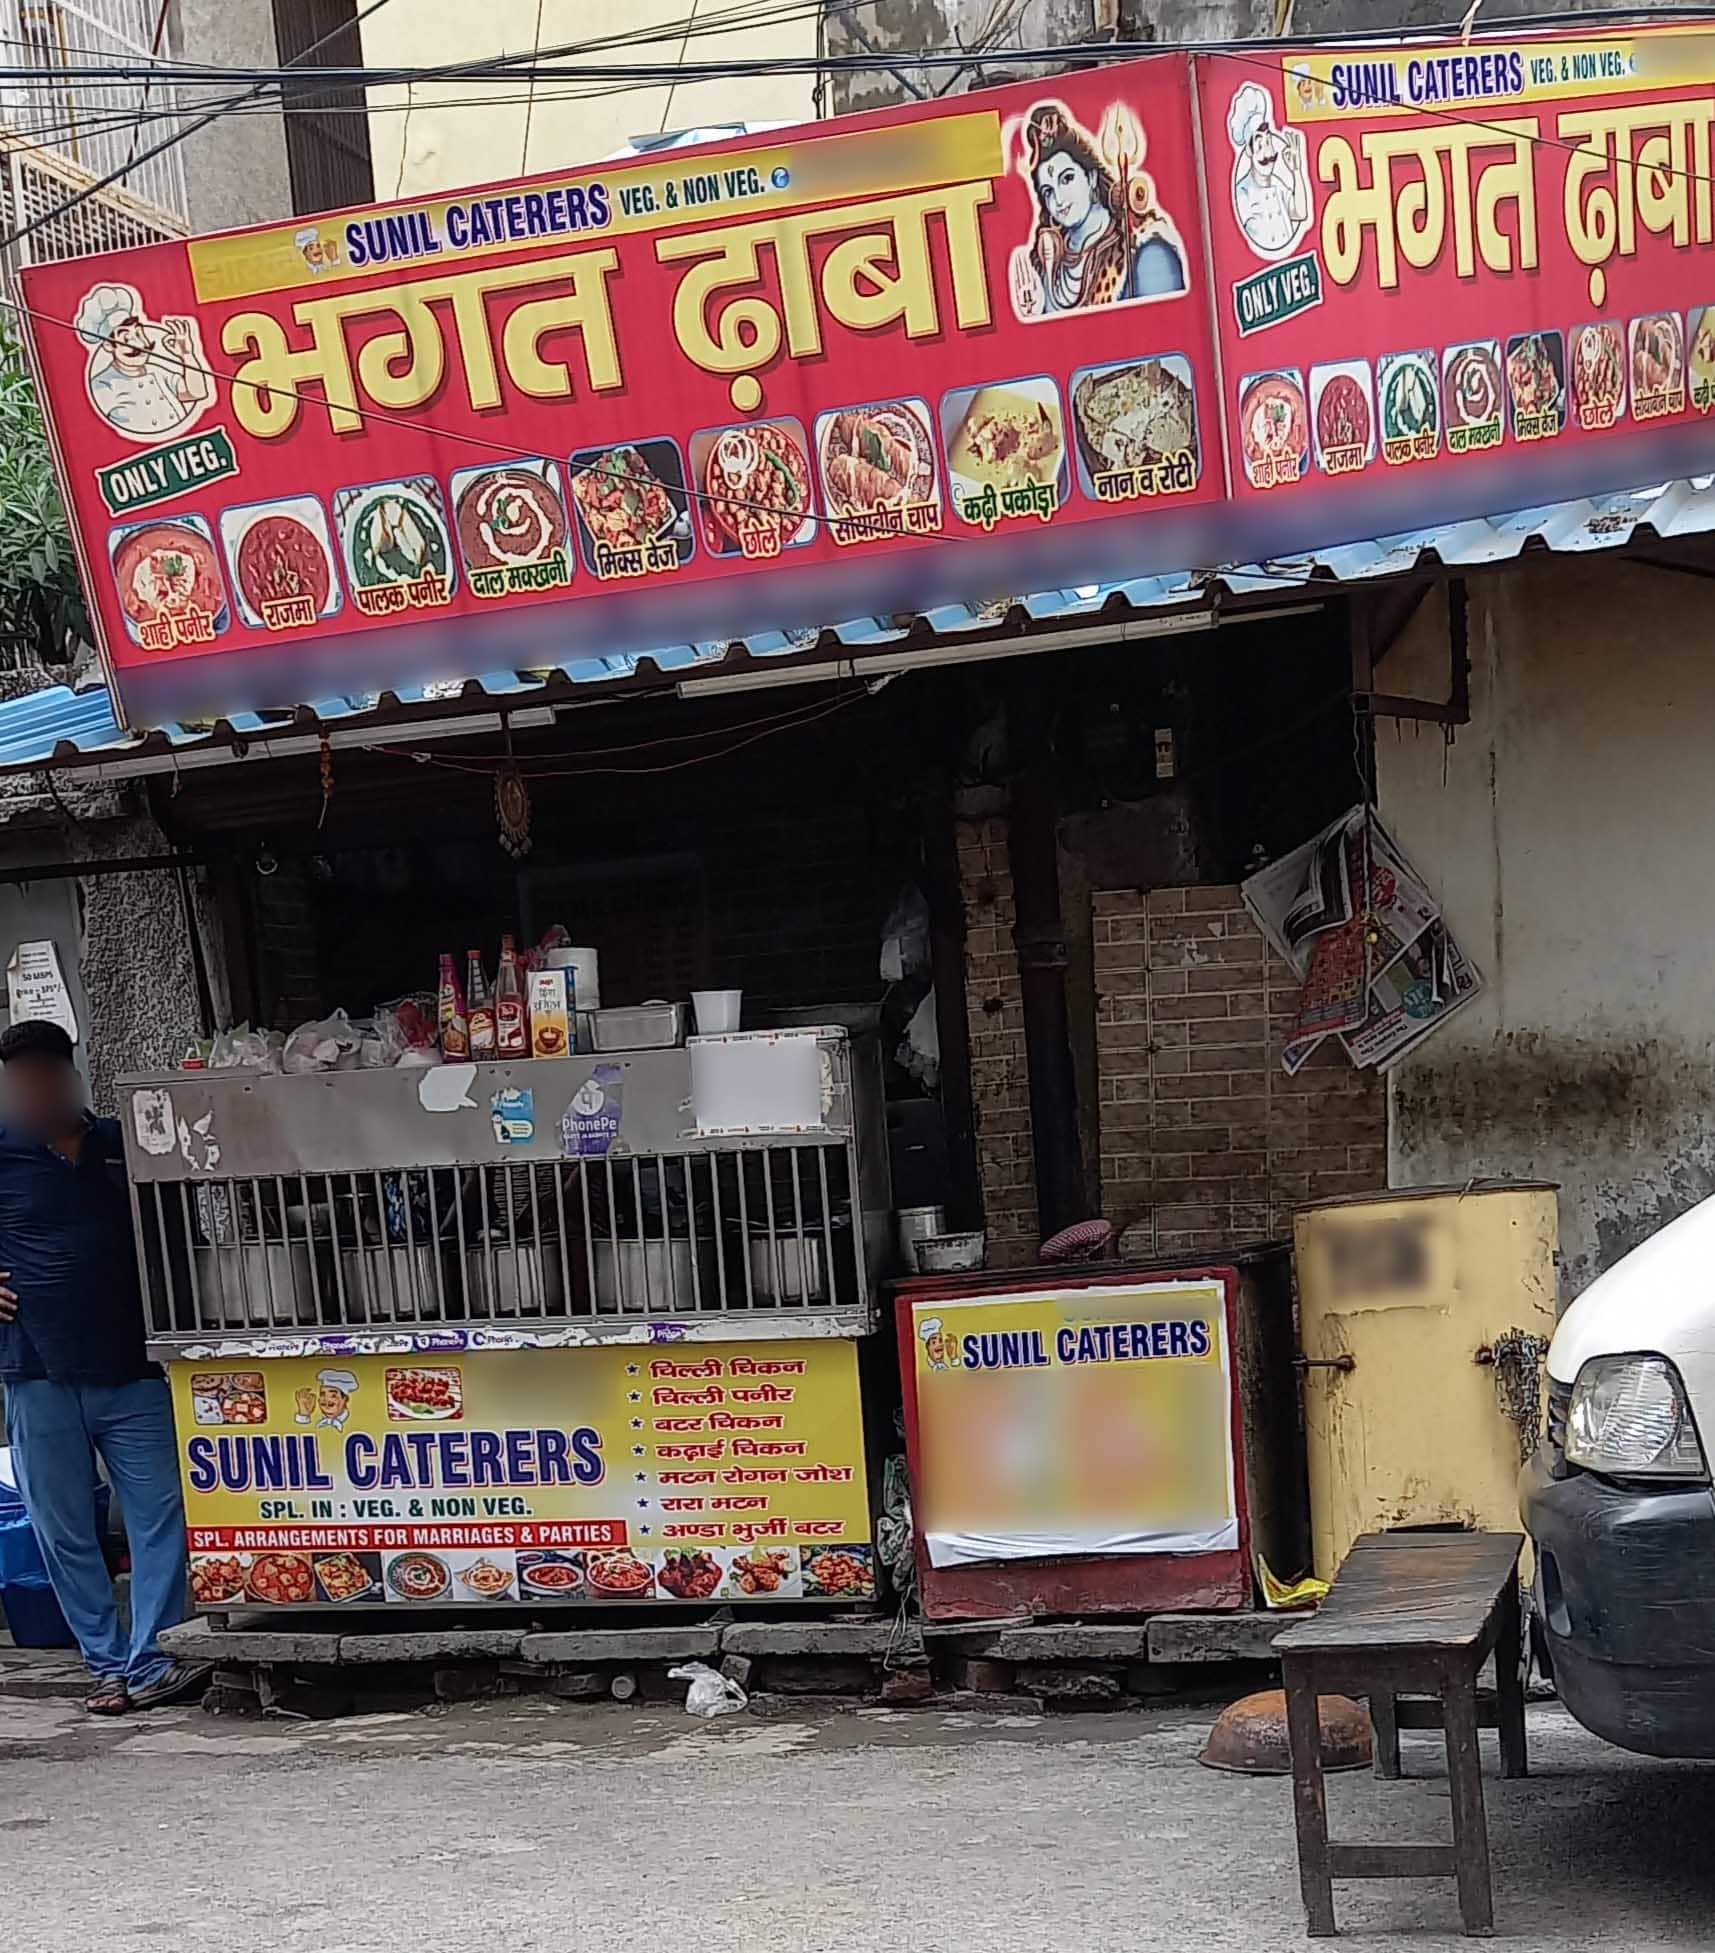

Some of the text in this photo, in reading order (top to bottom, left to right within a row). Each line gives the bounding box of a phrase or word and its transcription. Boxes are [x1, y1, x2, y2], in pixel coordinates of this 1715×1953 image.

[1332, 52, 1626, 108] SUNIL CATERERS VEG. & NON VEG.
[1317, 117, 1540, 290] भगत
[346, 168, 766, 266] SUNIL CATERERS VEG. & NON VEG.
[1241, 264, 1316, 320] ONLY VEG.
[221, 247, 623, 440] भगत
[1582, 398, 1615, 426] छोले
[1449, 428, 1467, 450] दाल
[1326, 446, 1364, 472] राजमा
[109, 448, 227, 504] ONLY VEG.
[1096, 469, 1136, 499] नान
[1157, 452, 1194, 491] रोटी
[907, 504, 940, 530] चाप
[741, 520, 778, 555] छोले
[647, 545, 678, 570] वेज
[356, 571, 448, 613] पालक पनीर
[471, 570, 505, 594] दाल
[263, 600, 315, 628] राजमा
[140, 608, 214, 647] शाही पनीर
[562, 1117, 618, 1131] PhonePe
[963, 1320, 1210, 1371] SUNIL CATERERS
[650, 1358, 805, 1378] चिल्ली चिकन
[653, 1384, 794, 1405] चिल्ली पनीर
[708, 1412, 783, 1430] चिकन
[188, 1428, 606, 1492] SUNIL CATERERS
[732, 1438, 806, 1457] चिकन
[658, 1464, 853, 1484] मटन रोगन जोश
[260, 1501, 304, 1520] SPL.
[312, 1501, 333, 1519] IN
[354, 1500, 401, 1519] VEG.
[409, 1499, 424, 1518] &
[431, 1498, 476, 1517] NON
[482, 1497, 533, 1516] VEG.
[661, 1496, 769, 1511] रारा मटन
[193, 1524, 612, 1548] SPL. ARRANGEMENTS FOR MARRIAGES & PARTIES
[663, 1522, 724, 1537] अण्डा
